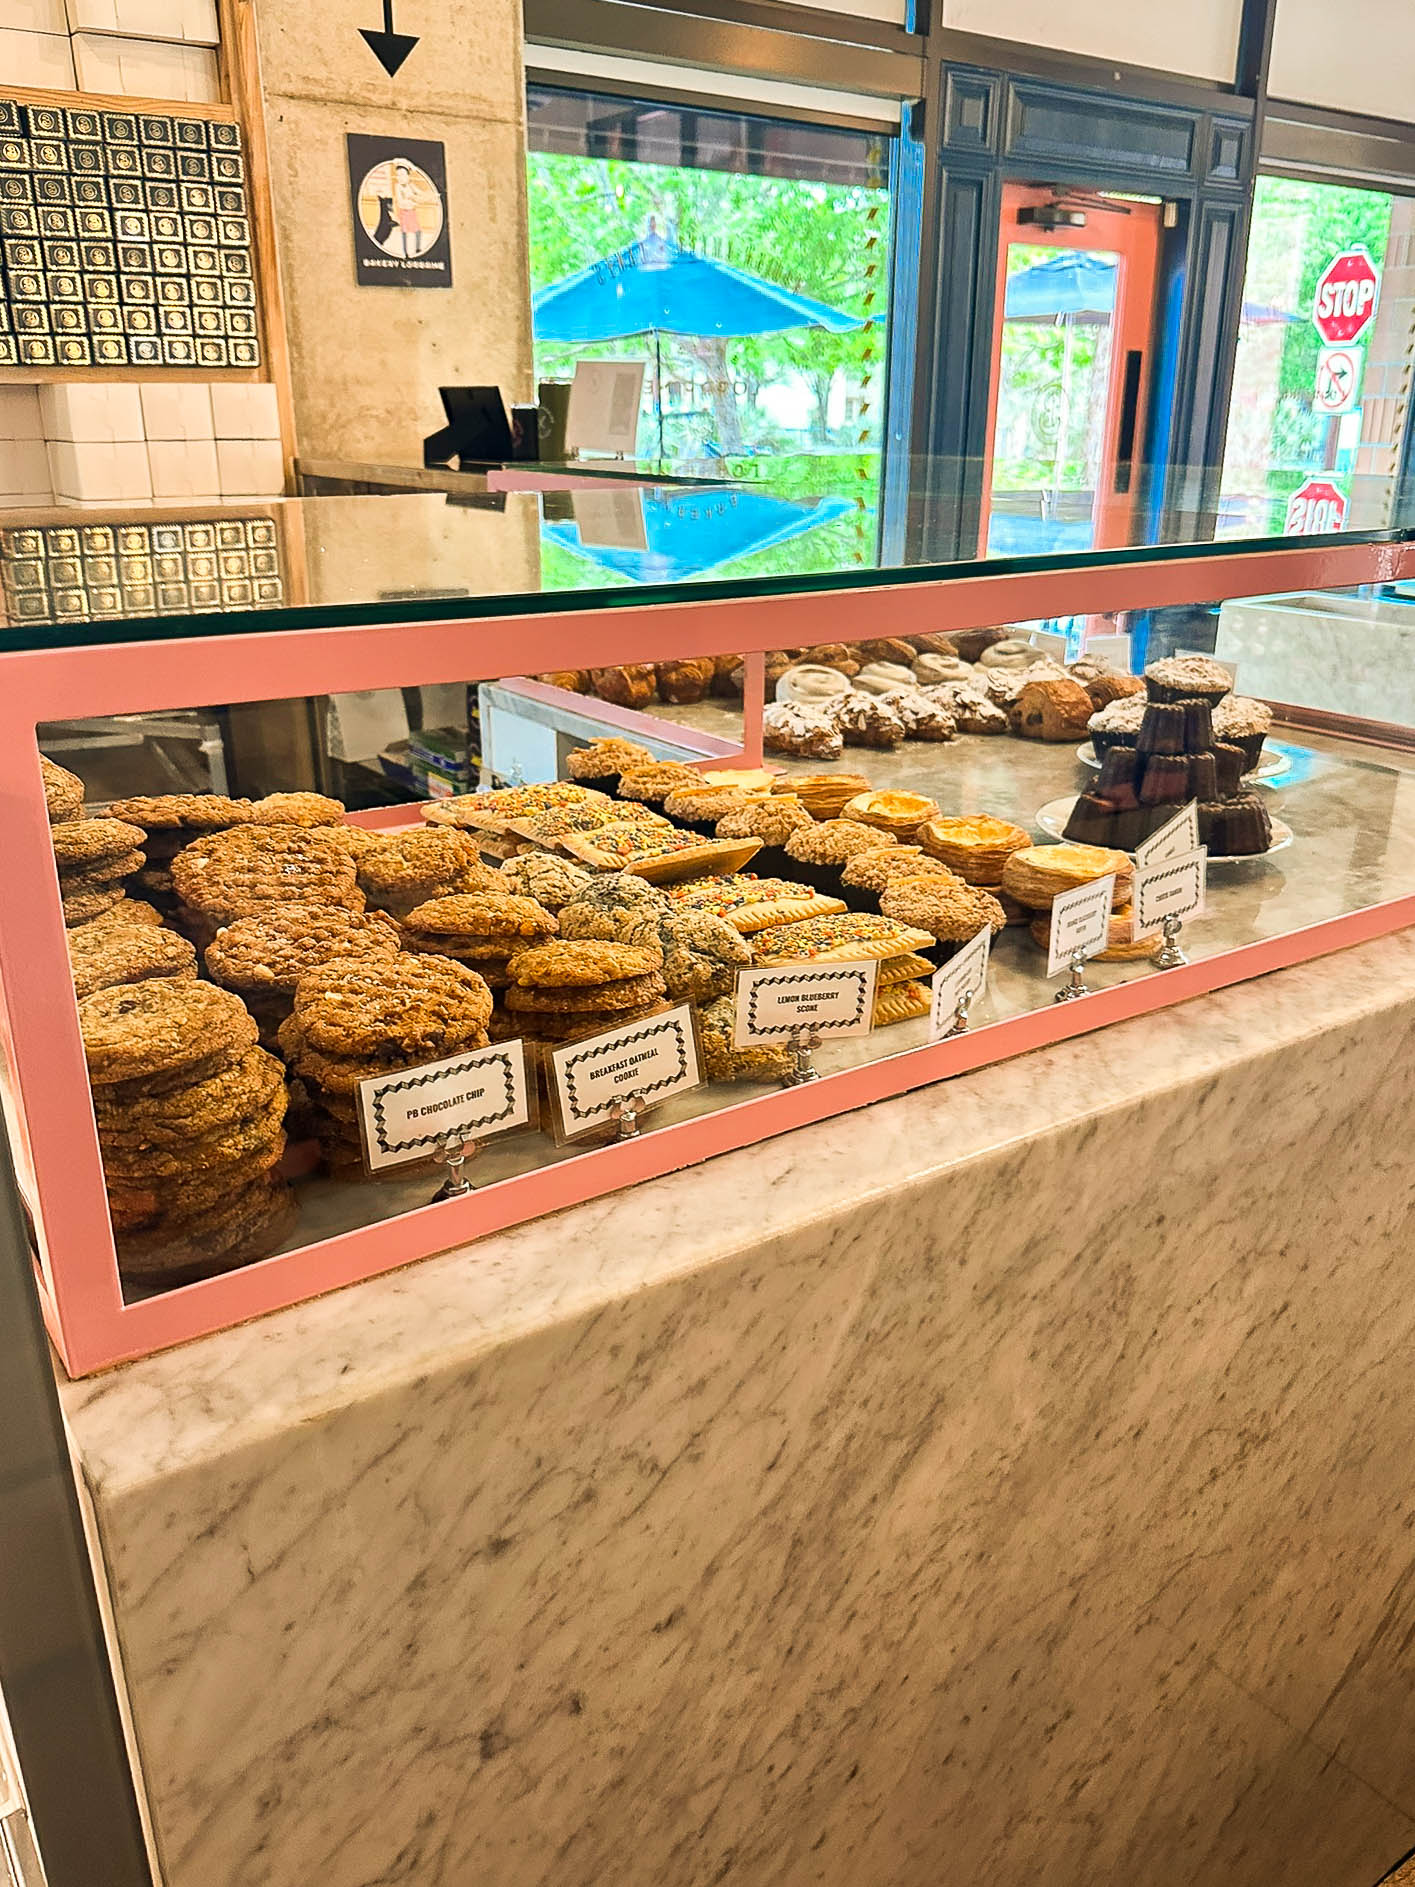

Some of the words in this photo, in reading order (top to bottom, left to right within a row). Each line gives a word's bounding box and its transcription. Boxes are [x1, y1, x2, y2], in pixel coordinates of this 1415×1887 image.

[1318, 279, 1375, 319] STOP
[777, 995, 800, 1004] LEMON
[801, 991, 840, 1002] BLUEBERRY
[796, 1004, 819, 1013] SCONE
[589, 1058, 629, 1080] BREAKFAST
[628, 1048, 660, 1066] OATMEAL
[613, 1067, 640, 1084] COOKIE
[406, 1109, 419, 1119] PB
[420, 1094, 465, 1116] CHOCOLATE
[465, 1087, 486, 1101] CHIP
